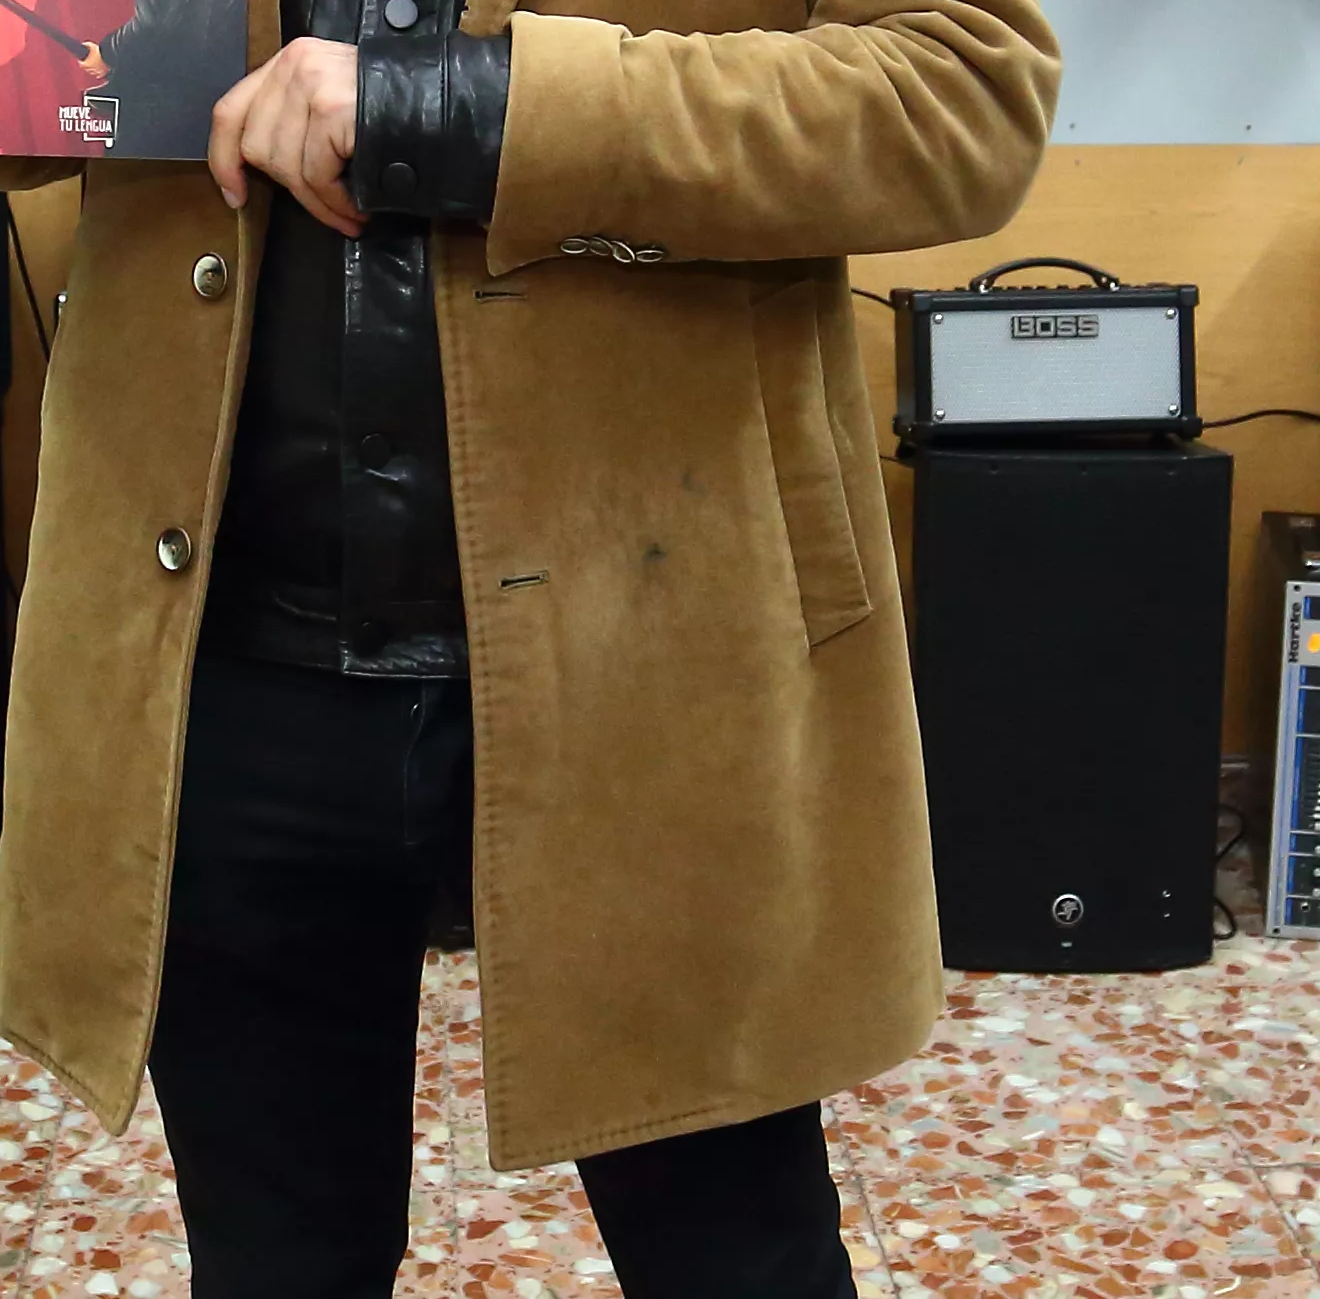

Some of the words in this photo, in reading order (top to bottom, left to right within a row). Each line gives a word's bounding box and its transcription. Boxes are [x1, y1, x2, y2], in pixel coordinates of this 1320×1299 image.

[60, 119, 73, 132] TU
[75, 119, 113, 133] LENGUA
[1011, 313, 1099, 338] BOSS
[1288, 601, 1303, 664] Hartke
